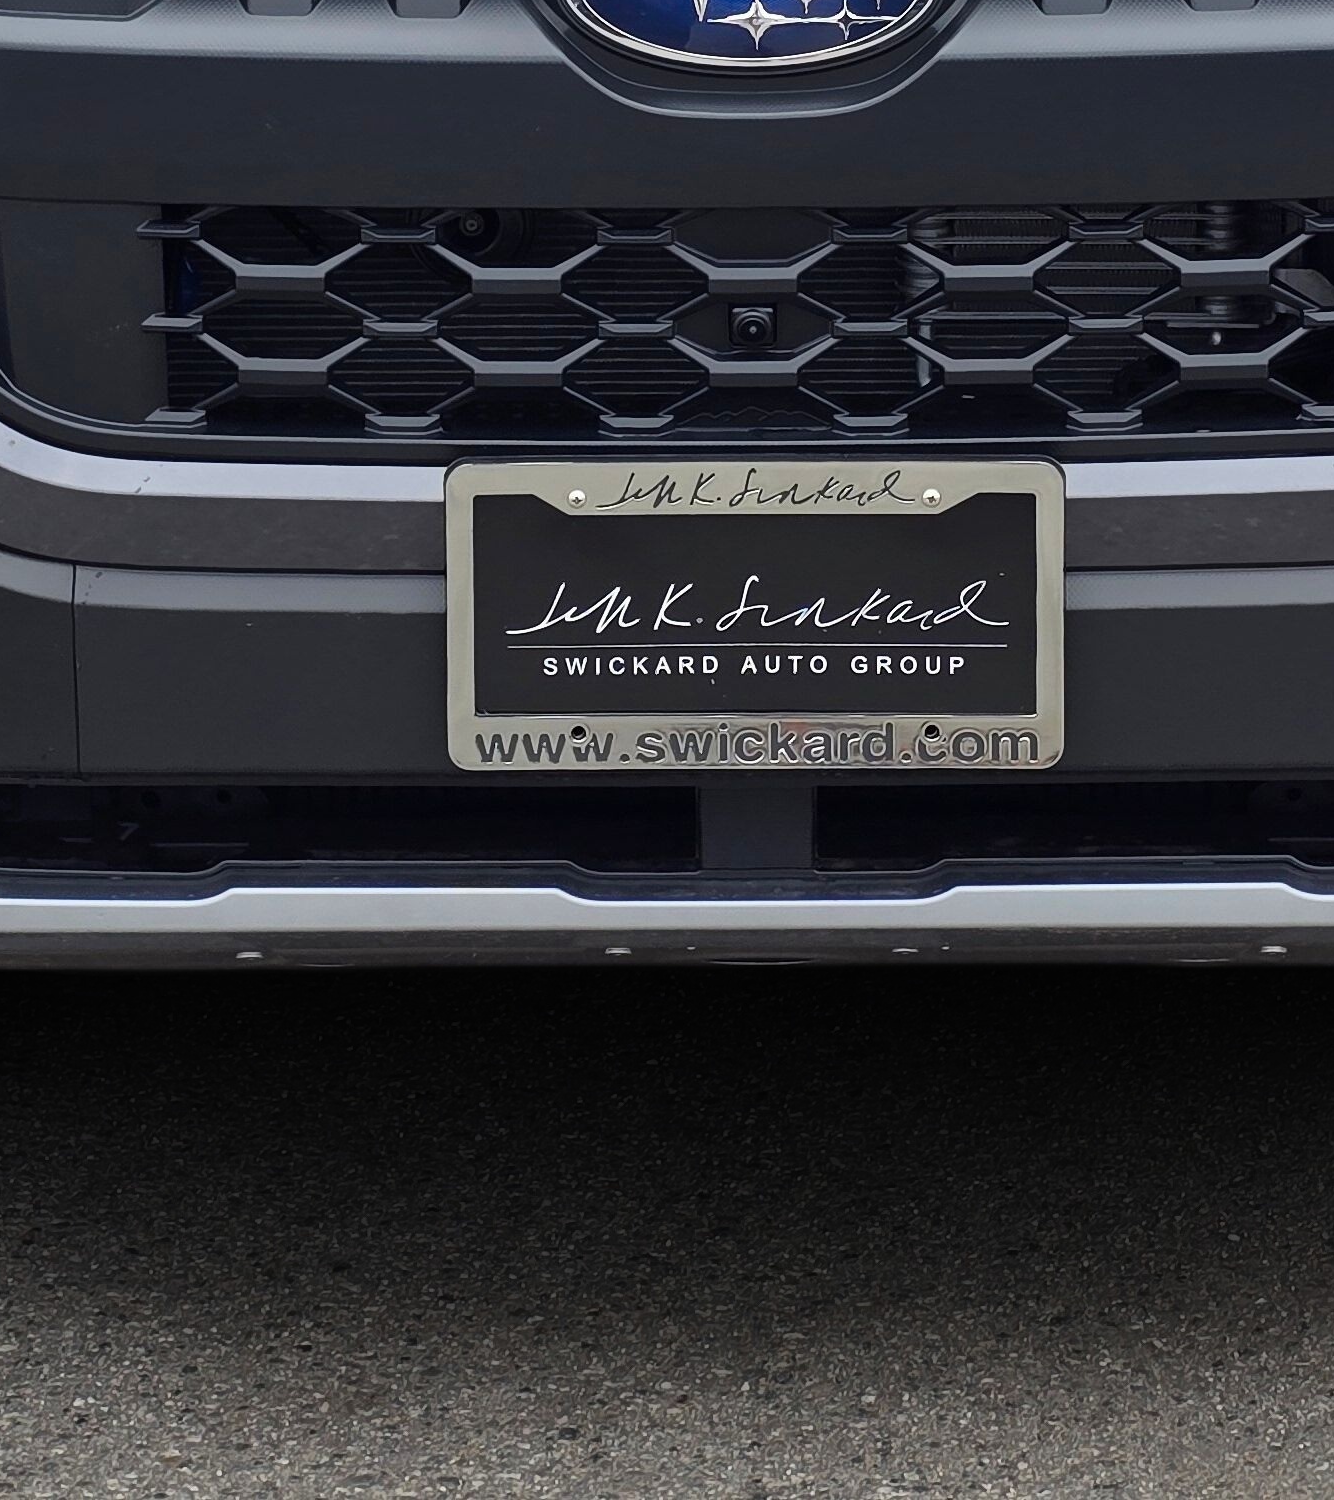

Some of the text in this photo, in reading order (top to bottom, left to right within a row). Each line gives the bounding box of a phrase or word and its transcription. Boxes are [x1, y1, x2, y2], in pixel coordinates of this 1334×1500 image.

[542, 655, 965, 676] SWICKARD AUTO GROUP
[475, 722, 1040, 765] www.swickard.com
